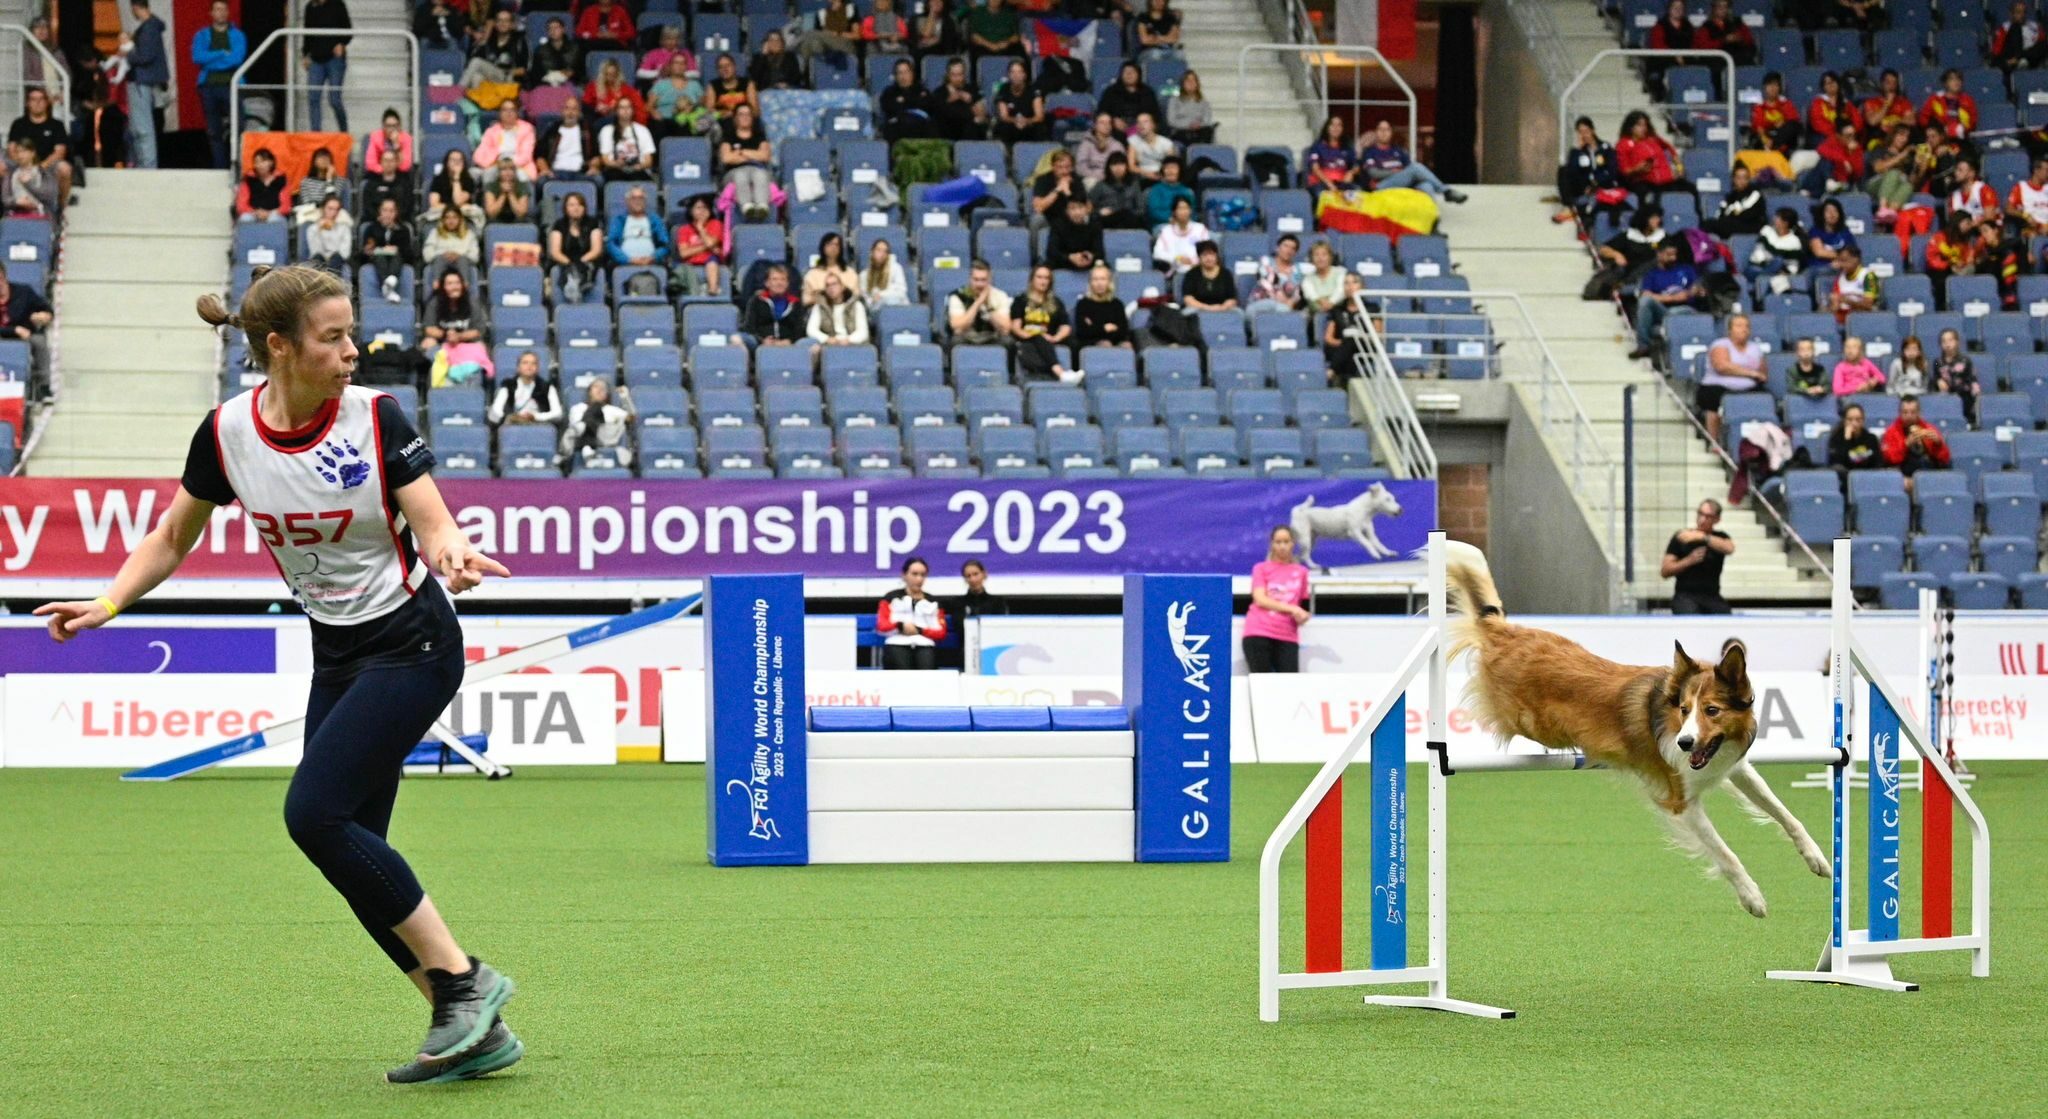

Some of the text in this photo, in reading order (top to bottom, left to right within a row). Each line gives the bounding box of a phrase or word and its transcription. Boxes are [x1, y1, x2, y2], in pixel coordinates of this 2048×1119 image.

[251, 508, 354, 548] 357
[455, 489, 922, 570] ampionship
[946, 489, 1127, 554] 2023
[772, 635, 783, 669] Liberec
[81, 701, 275, 738] Liberec
[450, 691, 586, 745] UTA
[752, 598, 771, 811] FCI Agility World Championship
[772, 676, 785, 716] Republic
[773, 718, 784, 745] Czech
[1181, 634, 1211, 839] GALICAN
[773, 752, 784, 777] 2023
[1389, 768, 1398, 905] FCI Agility World Championship
[1882, 758, 1899, 919] GALICAN
